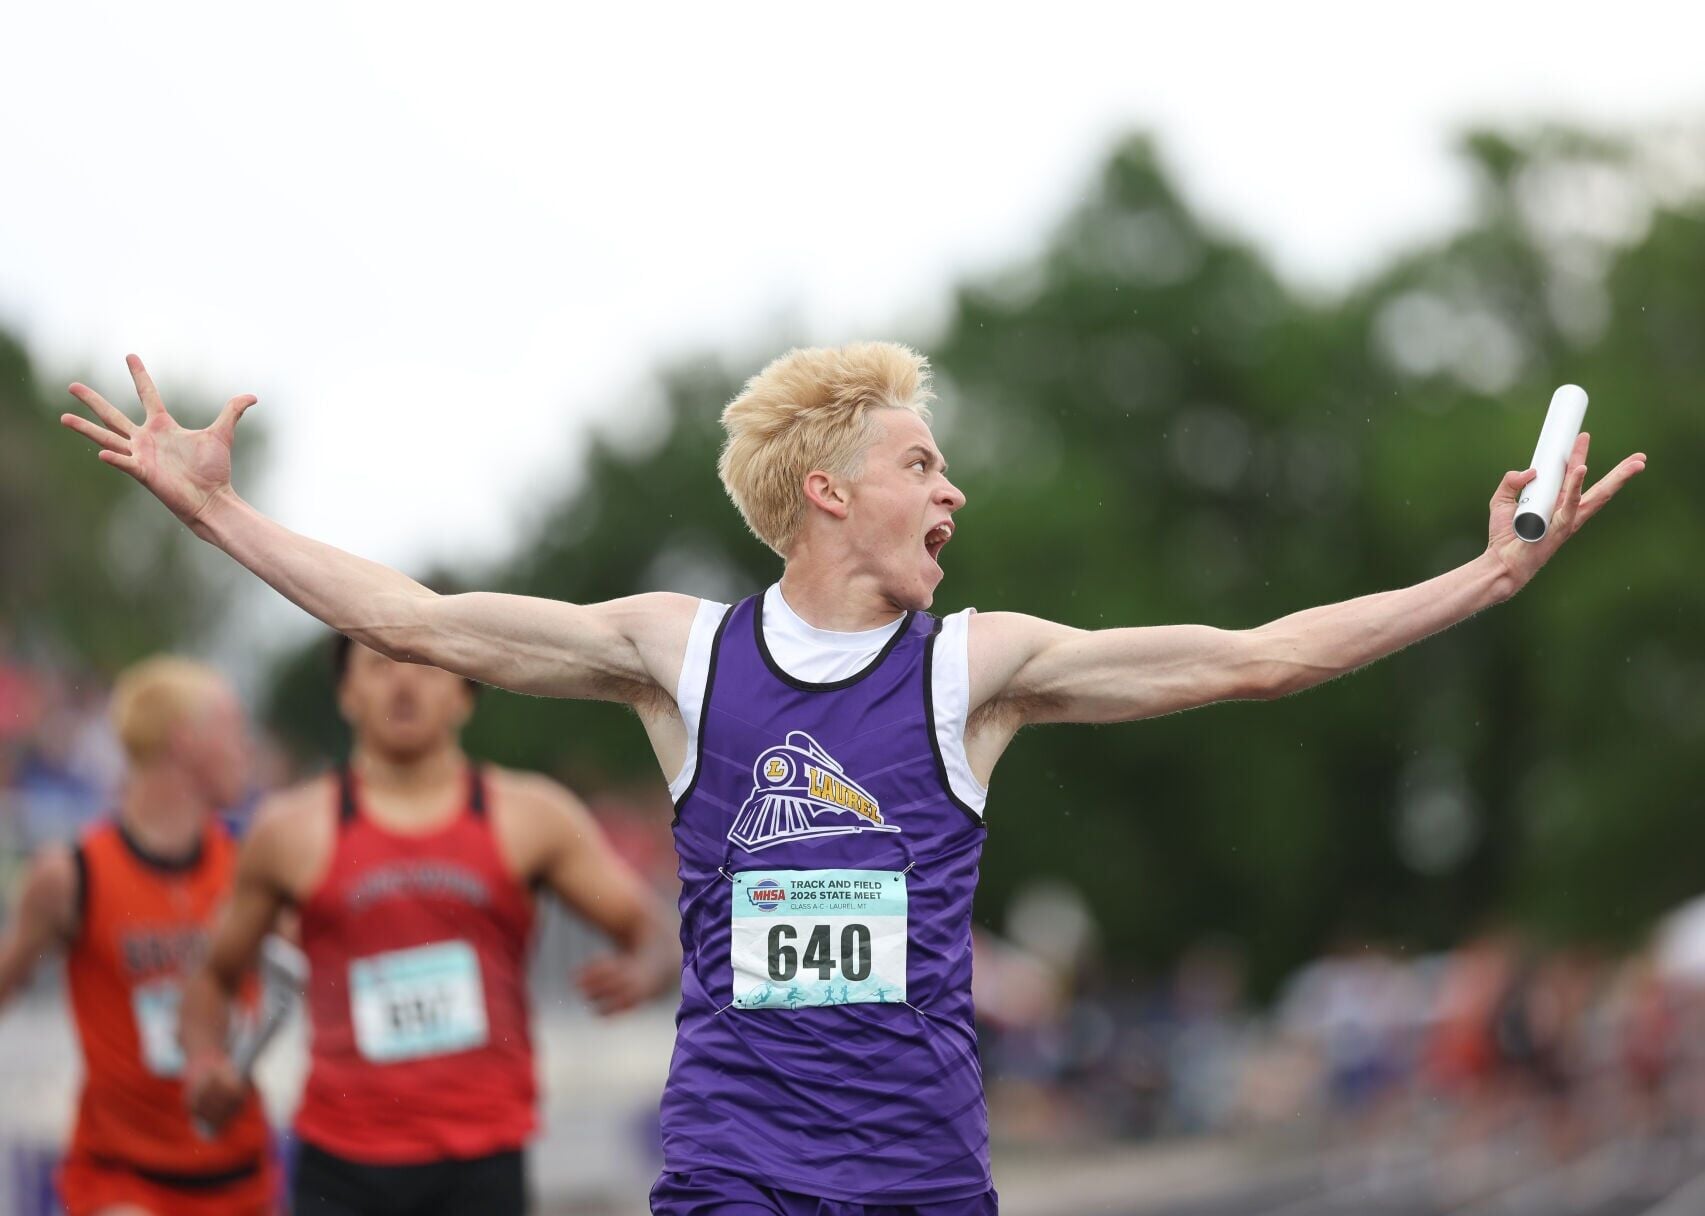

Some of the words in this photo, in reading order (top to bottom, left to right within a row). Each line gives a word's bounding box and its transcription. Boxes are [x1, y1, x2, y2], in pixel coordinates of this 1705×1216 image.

[767, 760, 784, 777] L
[809, 767, 882, 824] LAUREL
[790, 880, 825, 889] TRACK
[828, 880, 851, 889] AND
[854, 881, 882, 890] FIELD
[753, 889, 786, 901] MHSA
[790, 891, 817, 900] 2026
[819, 891, 852, 900] STATE
[854, 891, 882, 900] MEET
[767, 923, 872, 982] 640
